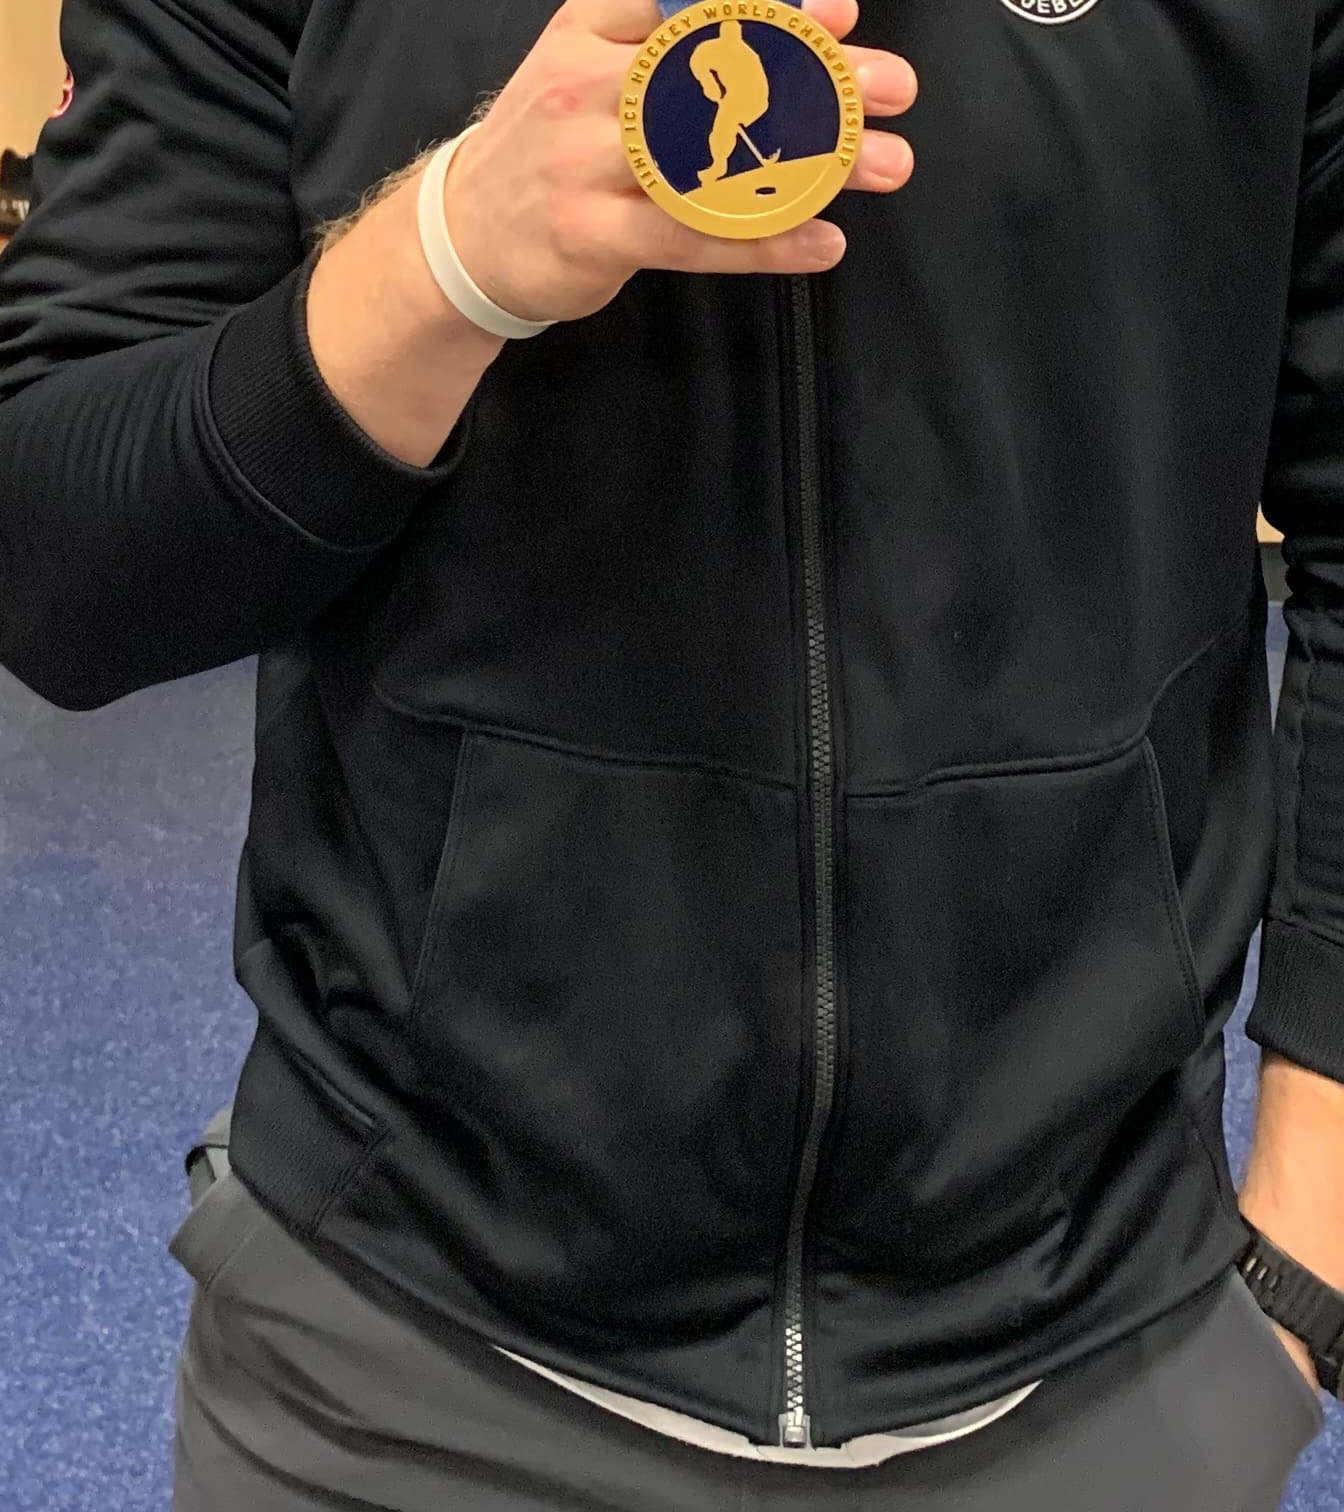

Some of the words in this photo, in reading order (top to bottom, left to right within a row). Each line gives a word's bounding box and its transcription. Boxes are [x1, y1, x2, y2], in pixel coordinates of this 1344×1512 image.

[702, 3, 777, 21] WORLD
[631, 15, 693, 85] HOCKEY
[623, 95, 639, 133] ICE
[787, 15, 859, 168] CHAMPIONSHIP
[628, 142, 660, 189] IIHF
